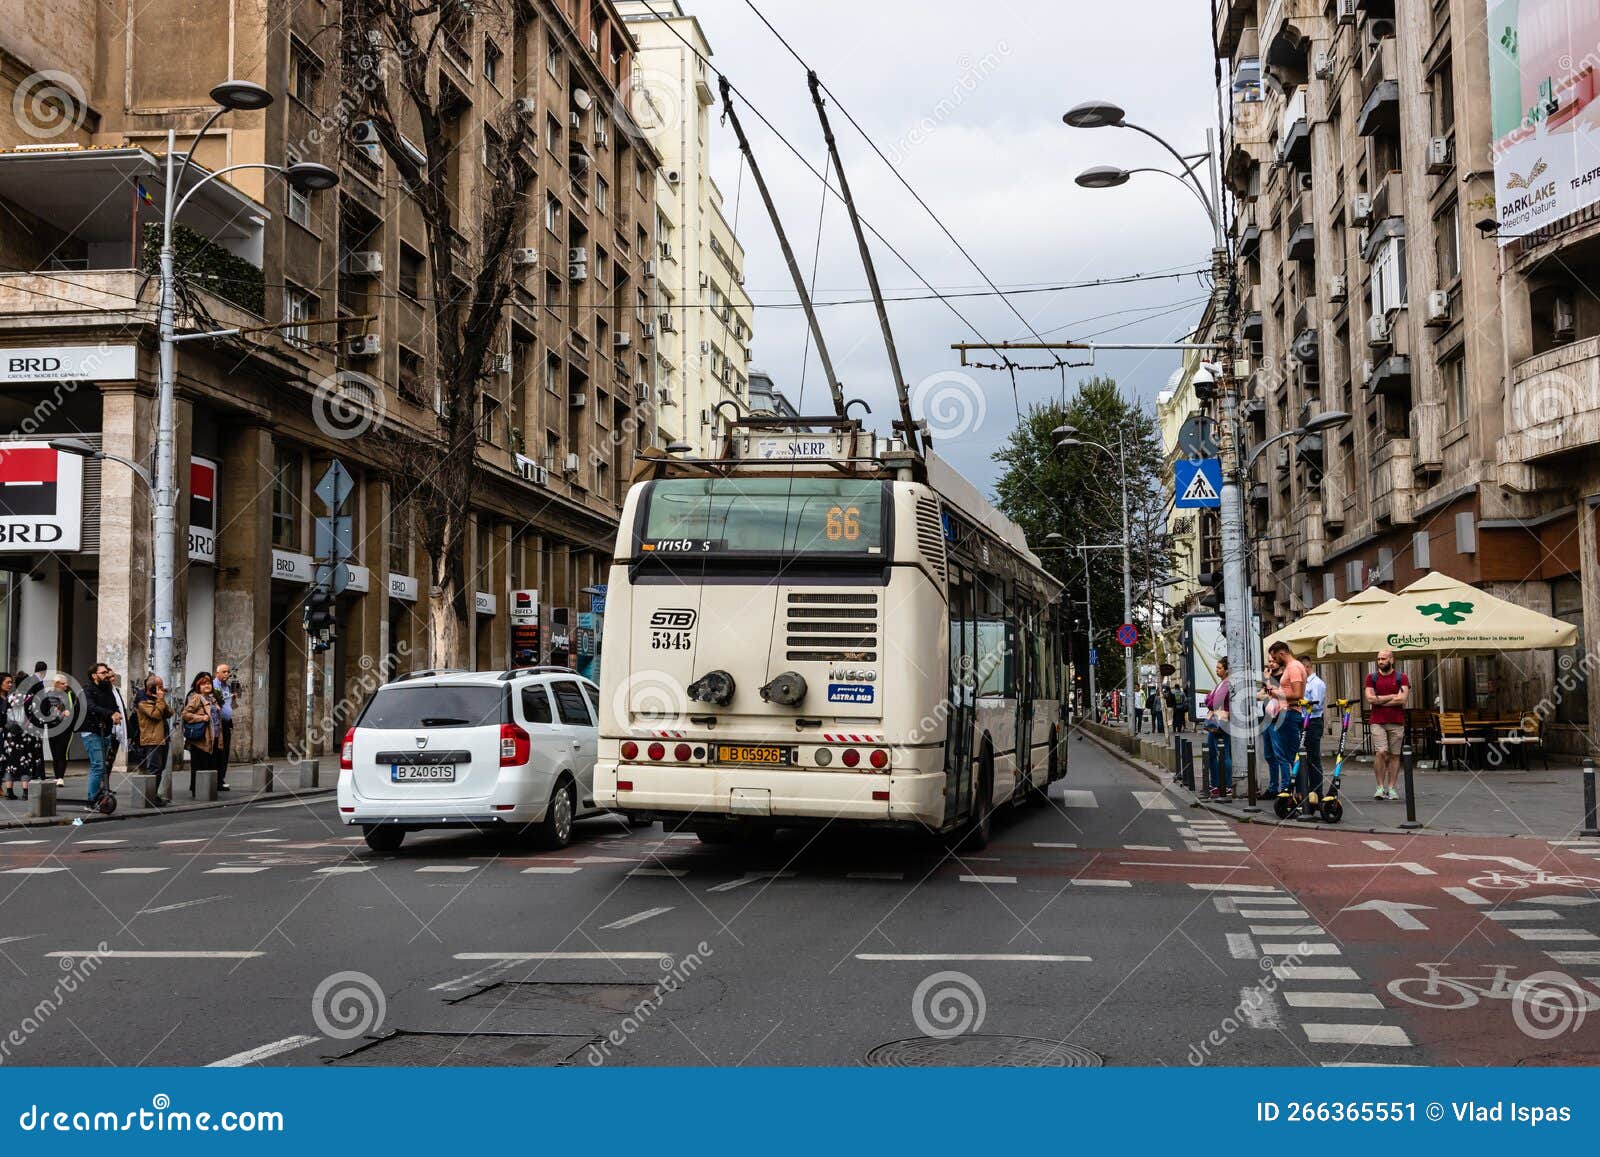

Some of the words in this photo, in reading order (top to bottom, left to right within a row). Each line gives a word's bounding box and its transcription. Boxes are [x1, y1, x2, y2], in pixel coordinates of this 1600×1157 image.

[1570, 177, 1580, 190] TE
[1502, 211, 1530, 231] Meeting
[1531, 199, 1557, 216] Nature
[9, 357, 61, 373] BRD
[788, 442, 825, 455] SAERP
[827, 506, 860, 541] 66
[276, 558, 295, 573] BRD
[391, 580, 406, 593] BRD
[650, 612, 693, 626] STB
[652, 631, 691, 650] 5345
[1387, 633, 1430, 649] Carlsberg
[828, 669, 877, 681] IVECO
[830, 693, 855, 701] ASTRA
[856, 694, 872, 702] BUS
[729, 747, 739, 761] B
[741, 748, 778, 762] 05926
[398, 766, 407, 778] B
